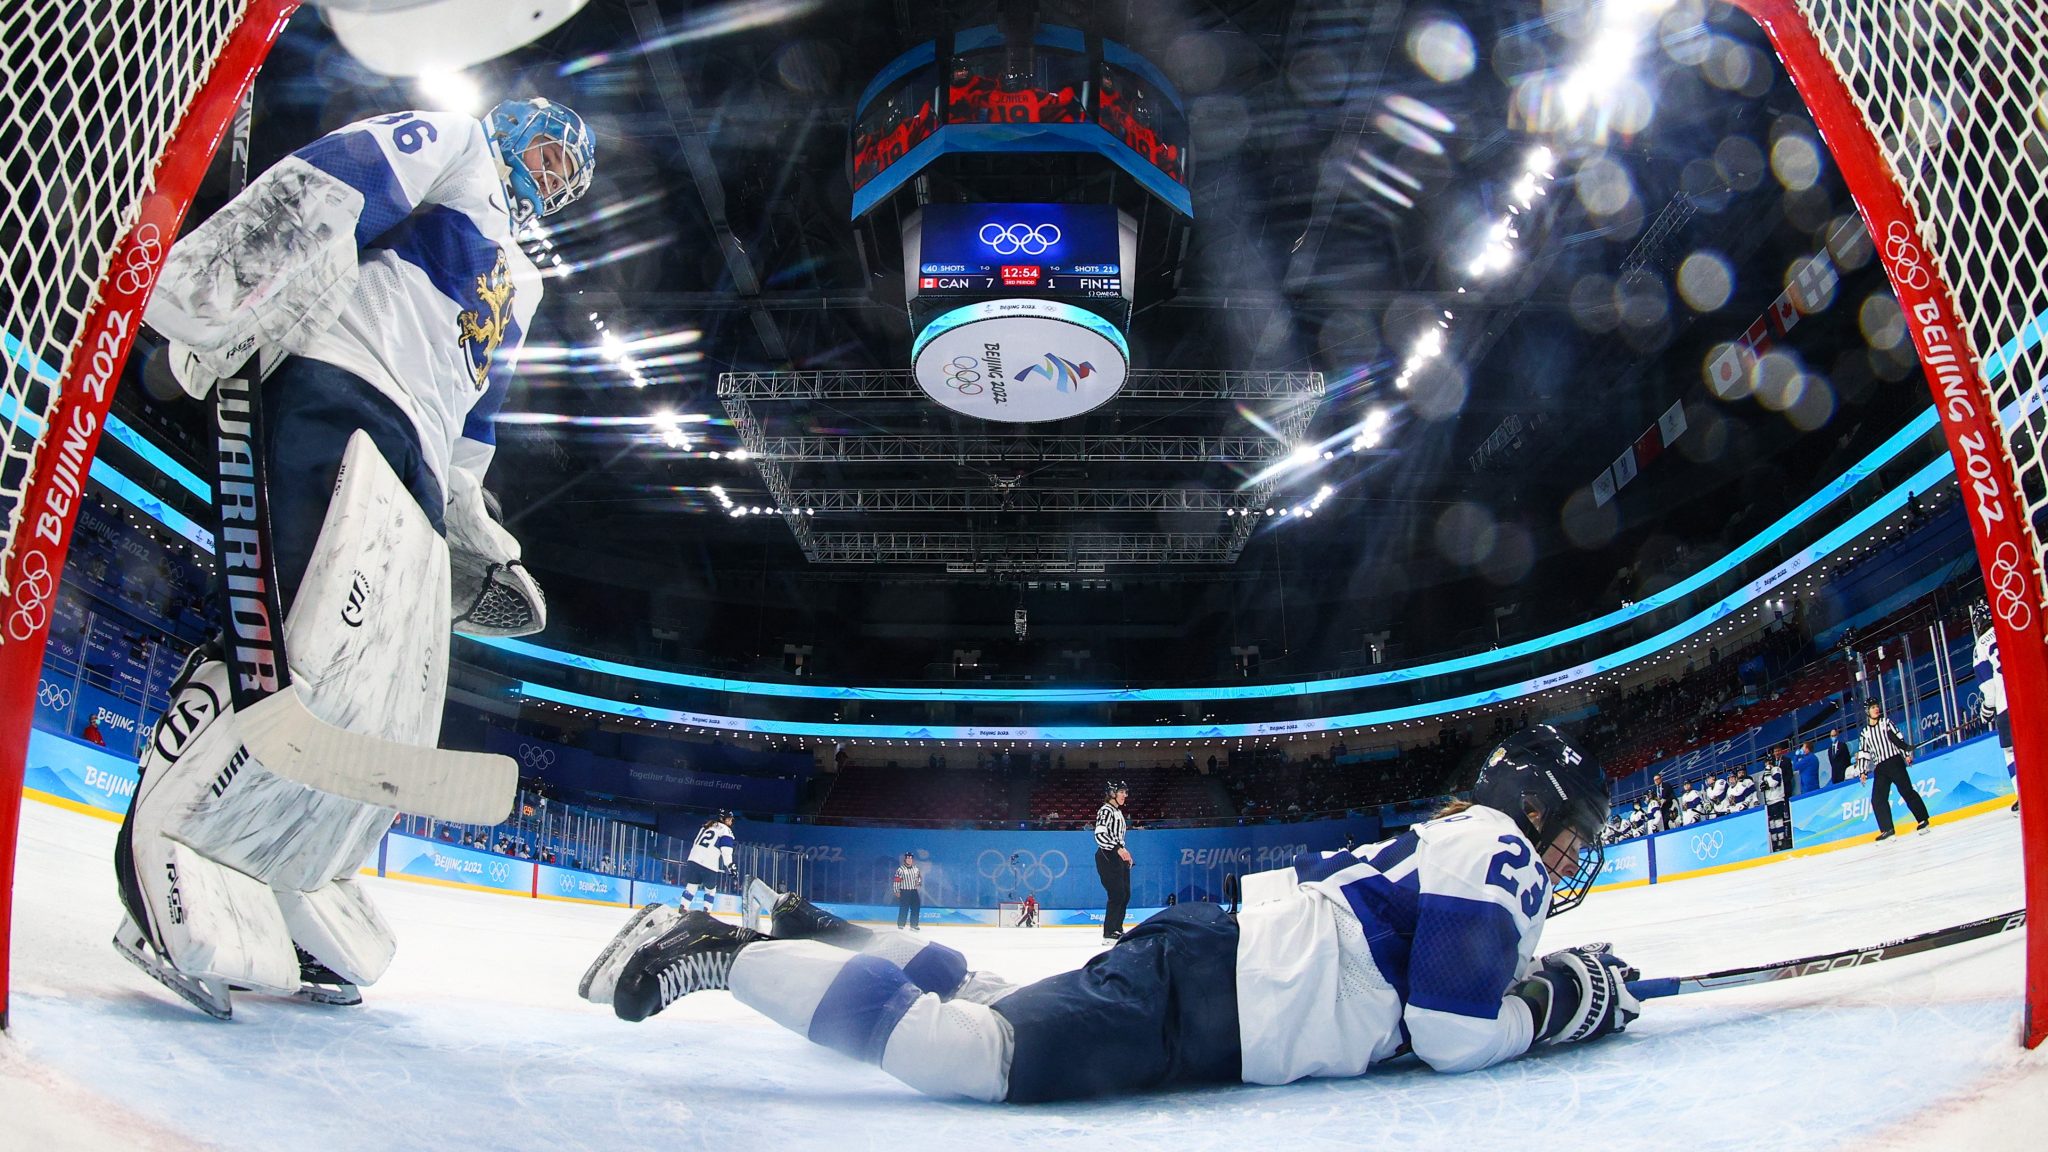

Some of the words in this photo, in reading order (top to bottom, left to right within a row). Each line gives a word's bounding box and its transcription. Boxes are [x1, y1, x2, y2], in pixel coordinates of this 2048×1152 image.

[1003, 267, 1039, 278] 12:54
[1074, 265, 1099, 273] SHOTS
[1103, 265, 1114, 273] 21
[938, 278, 969, 289] CAN
[985, 278, 994, 288] 7
[1047, 278, 1056, 289] 1
[1080, 278, 1102, 289] FIN
[984, 343, 1004, 380] BEIJING
[990, 380, 1007, 404] 2022
[36, 406, 97, 546] BEIJING
[83, 309, 133, 402] 2022
[1913, 297, 1975, 422] BEIJING
[1958, 430, 2004, 538] 2022
[78, 511, 121, 544] BEIJING
[122, 537, 150, 562] 2022
[216, 378, 280, 692] WARRIOR
[97, 706, 135, 733] BEIJING
[136, 722, 155, 737] 20
[1921, 712, 1942, 730] 022
[629, 768, 663, 784] Together
[664, 772, 678, 783] for
[684, 776, 714, 787] Shared
[715, 778, 742, 790] Future
[695, 828, 716, 848] 12
[434, 854, 462, 872] BEIJING
[463, 861, 483, 874] 2022
[1180, 848, 1252, 870] BEIJING
[579, 880, 595, 892] BEIJING
[1485, 834, 1550, 920] 23
